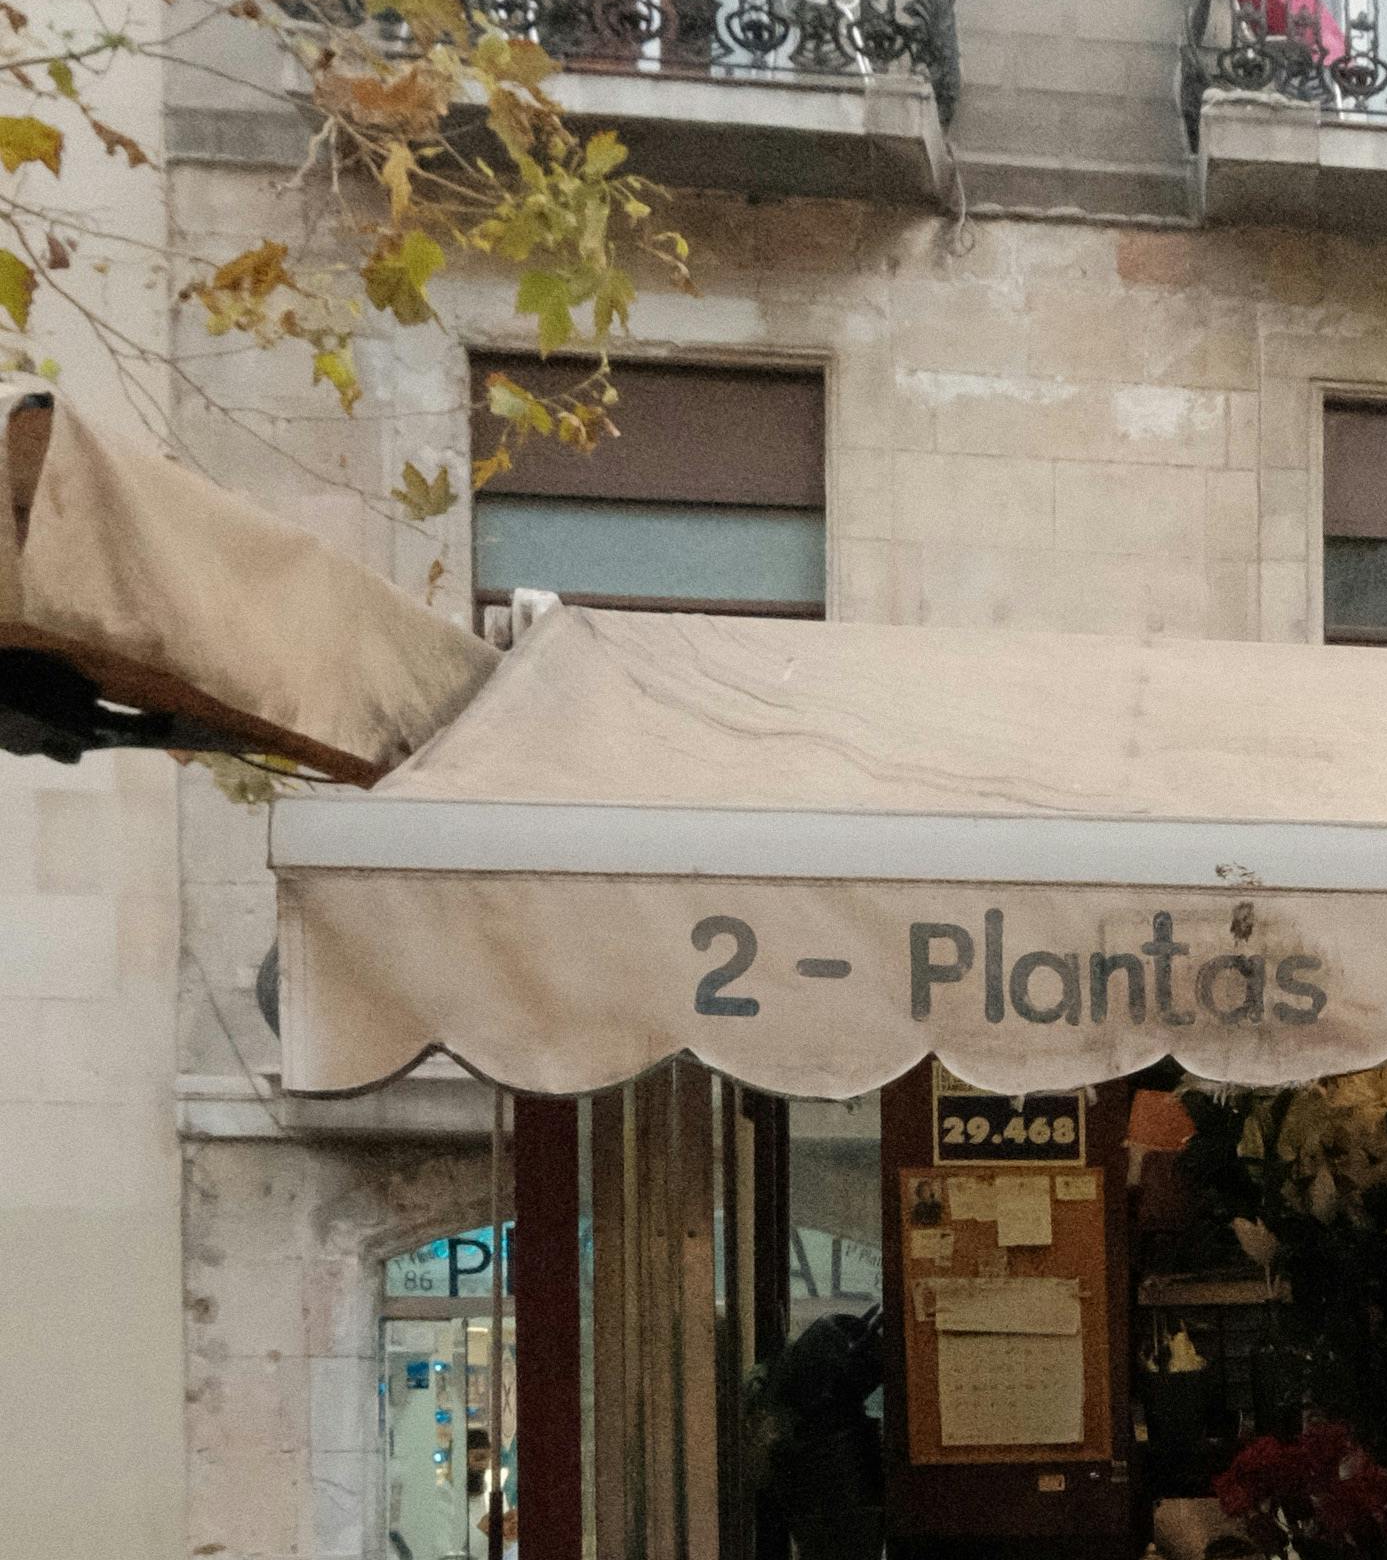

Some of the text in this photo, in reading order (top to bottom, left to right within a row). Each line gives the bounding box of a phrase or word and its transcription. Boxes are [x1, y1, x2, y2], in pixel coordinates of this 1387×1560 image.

[690, 914, 760, 1018] 2
[908, 908, 1327, 1027] Plantas
[942, 1116, 1076, 1144] 29.468
[403, 1269, 433, 1291] 86
